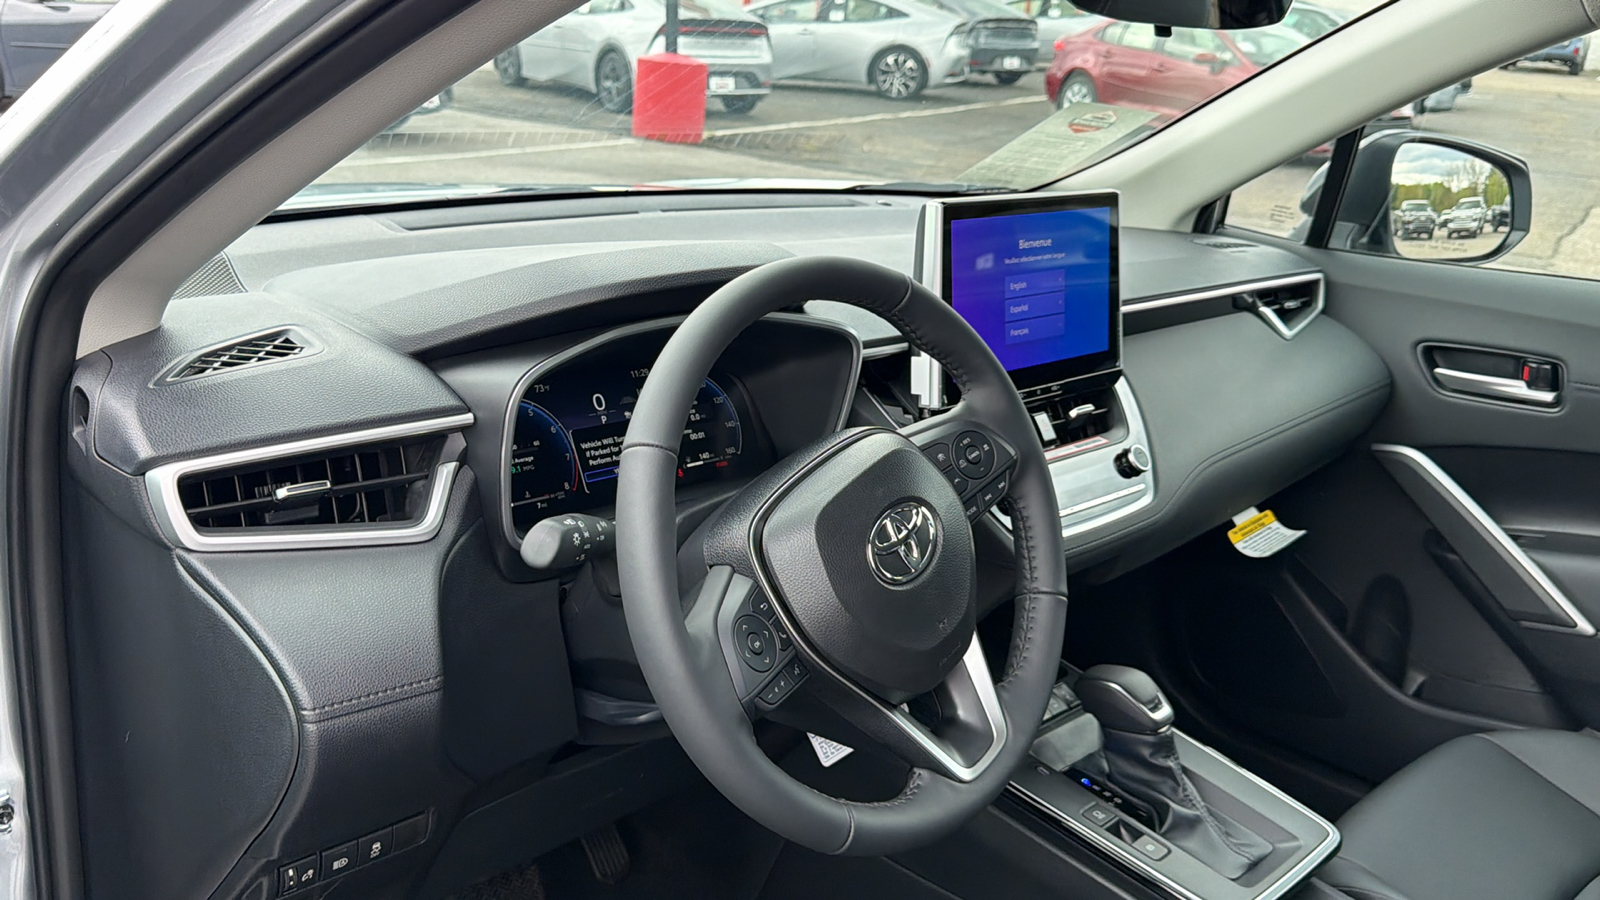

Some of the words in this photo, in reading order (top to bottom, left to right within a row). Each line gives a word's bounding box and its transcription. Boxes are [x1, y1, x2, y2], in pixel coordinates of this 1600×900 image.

[1018, 238, 1052, 249] Bienvenue
[1010, 281, 1027, 291] English
[1010, 303, 1029, 314] Español
[1010, 327, 1029, 337] Français
[630, 369, 649, 378] 11:29
[593, 393, 606, 410] 0
[713, 396, 724, 404] 120
[528, 409, 533, 417] 5
[601, 415, 607, 424] P
[690, 414, 701, 422] 0.0
[724, 420, 736, 428] 140
[689, 432, 706, 441] 00:01
[580, 439, 602, 450] Vehicle
[602, 437, 614, 446] Will
[565, 453, 570, 461] 7
[585, 450, 590, 458] If
[591, 448, 611, 457] Parked
[699, 452, 710, 460] 140
[589, 456, 612, 467] Perform
[563, 482, 570, 490] 8
